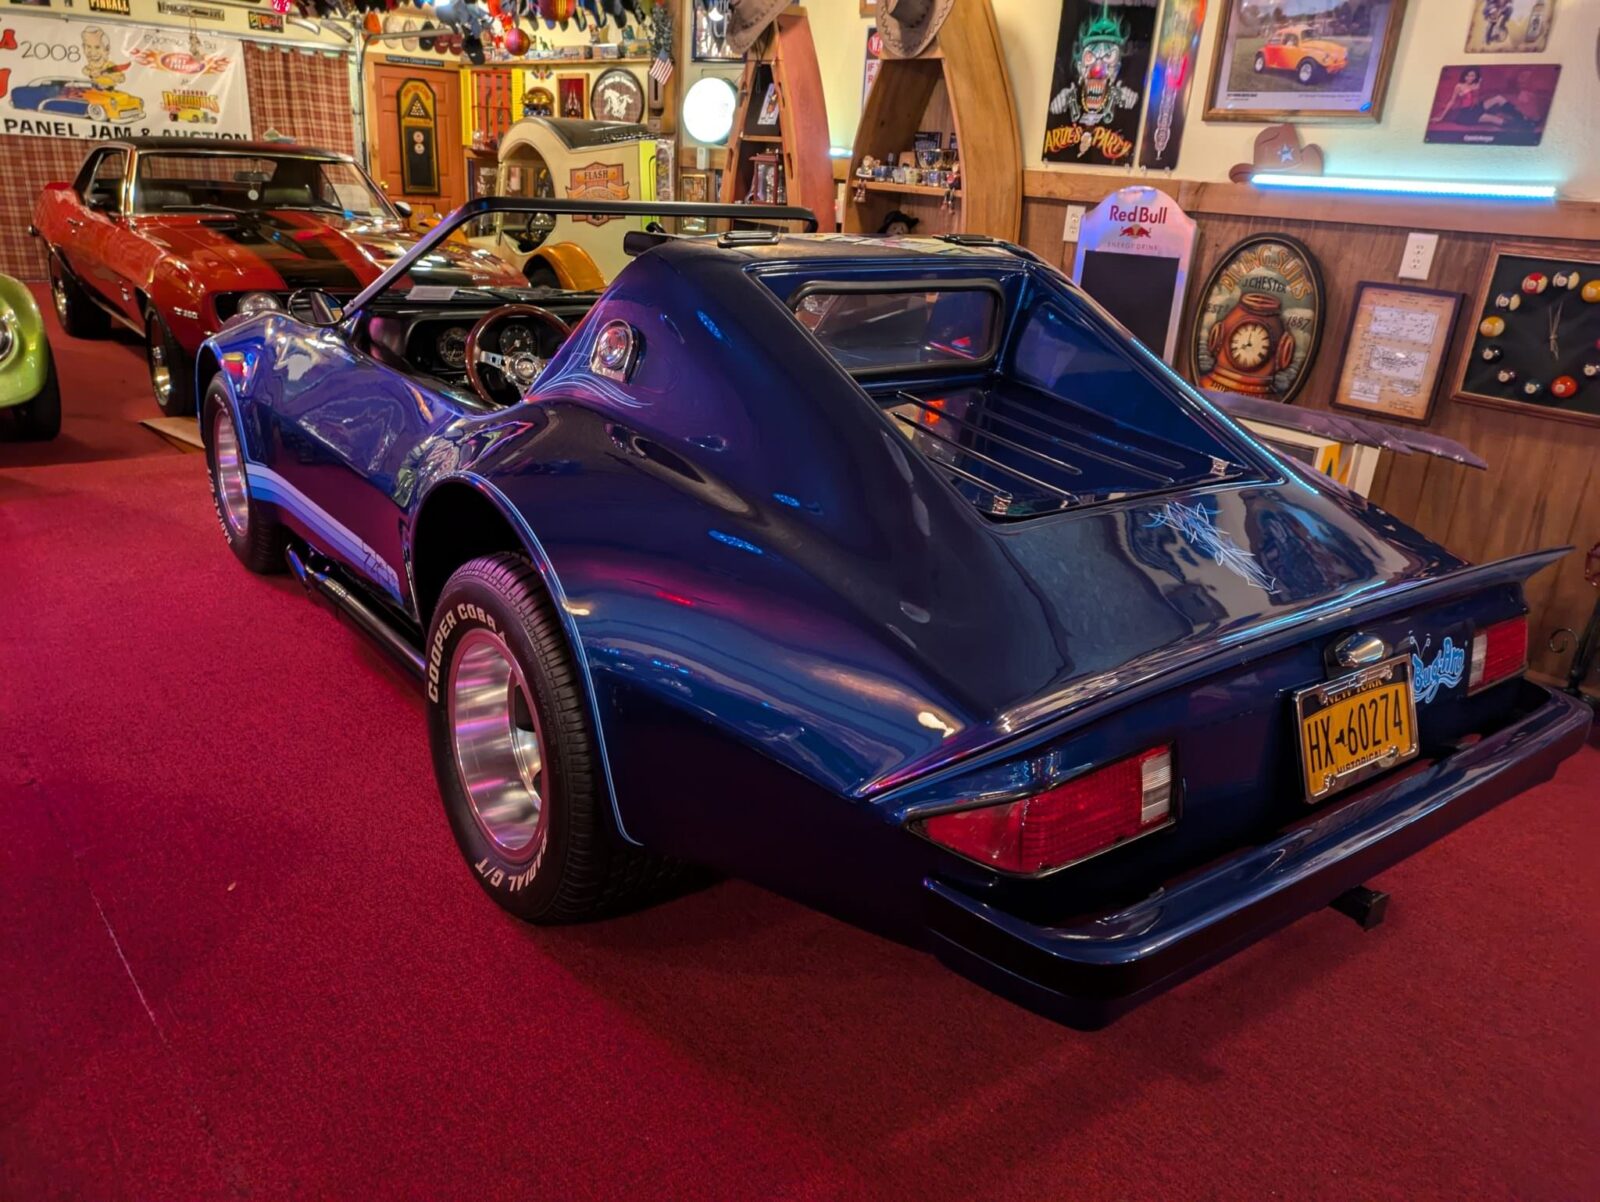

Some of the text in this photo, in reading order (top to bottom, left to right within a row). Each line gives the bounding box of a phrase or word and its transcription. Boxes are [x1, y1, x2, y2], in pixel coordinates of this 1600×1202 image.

[20, 40, 81, 63] 2008
[4, 119, 248, 141] PANEL JAM & AUCTION
[584, 169, 608, 180] FLASH
[1109, 205, 1168, 225] Red Bull
[1221, 244, 1312, 299] DIVING SUITS
[1287, 315, 1312, 331] 1887
[428, 612, 457, 703] COOPER
[1307, 689, 1403, 773] HX 60274
[474, 828, 548, 893] RADIAL G/T
